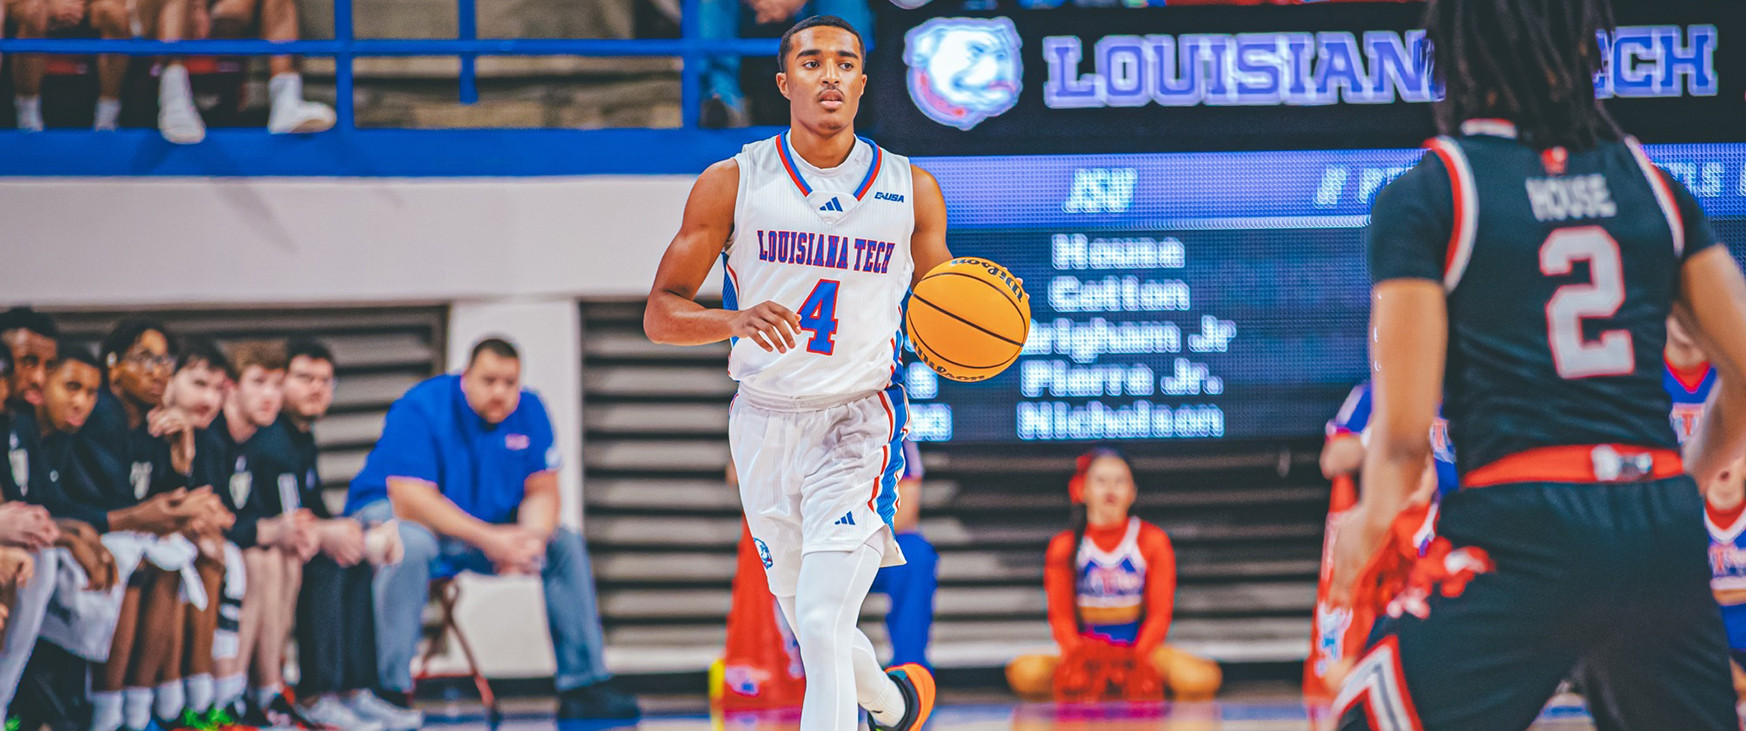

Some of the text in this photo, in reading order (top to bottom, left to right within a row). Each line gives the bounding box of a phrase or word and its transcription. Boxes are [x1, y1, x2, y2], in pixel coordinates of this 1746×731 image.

[1043, 24, 1718, 108] LOUISIAN CH
[1525, 173, 1617, 222] HOUSE
[757, 230, 896, 274] LOUISIANA TECH
[797, 279, 841, 356] 4
[1539, 225, 1636, 379] 2
